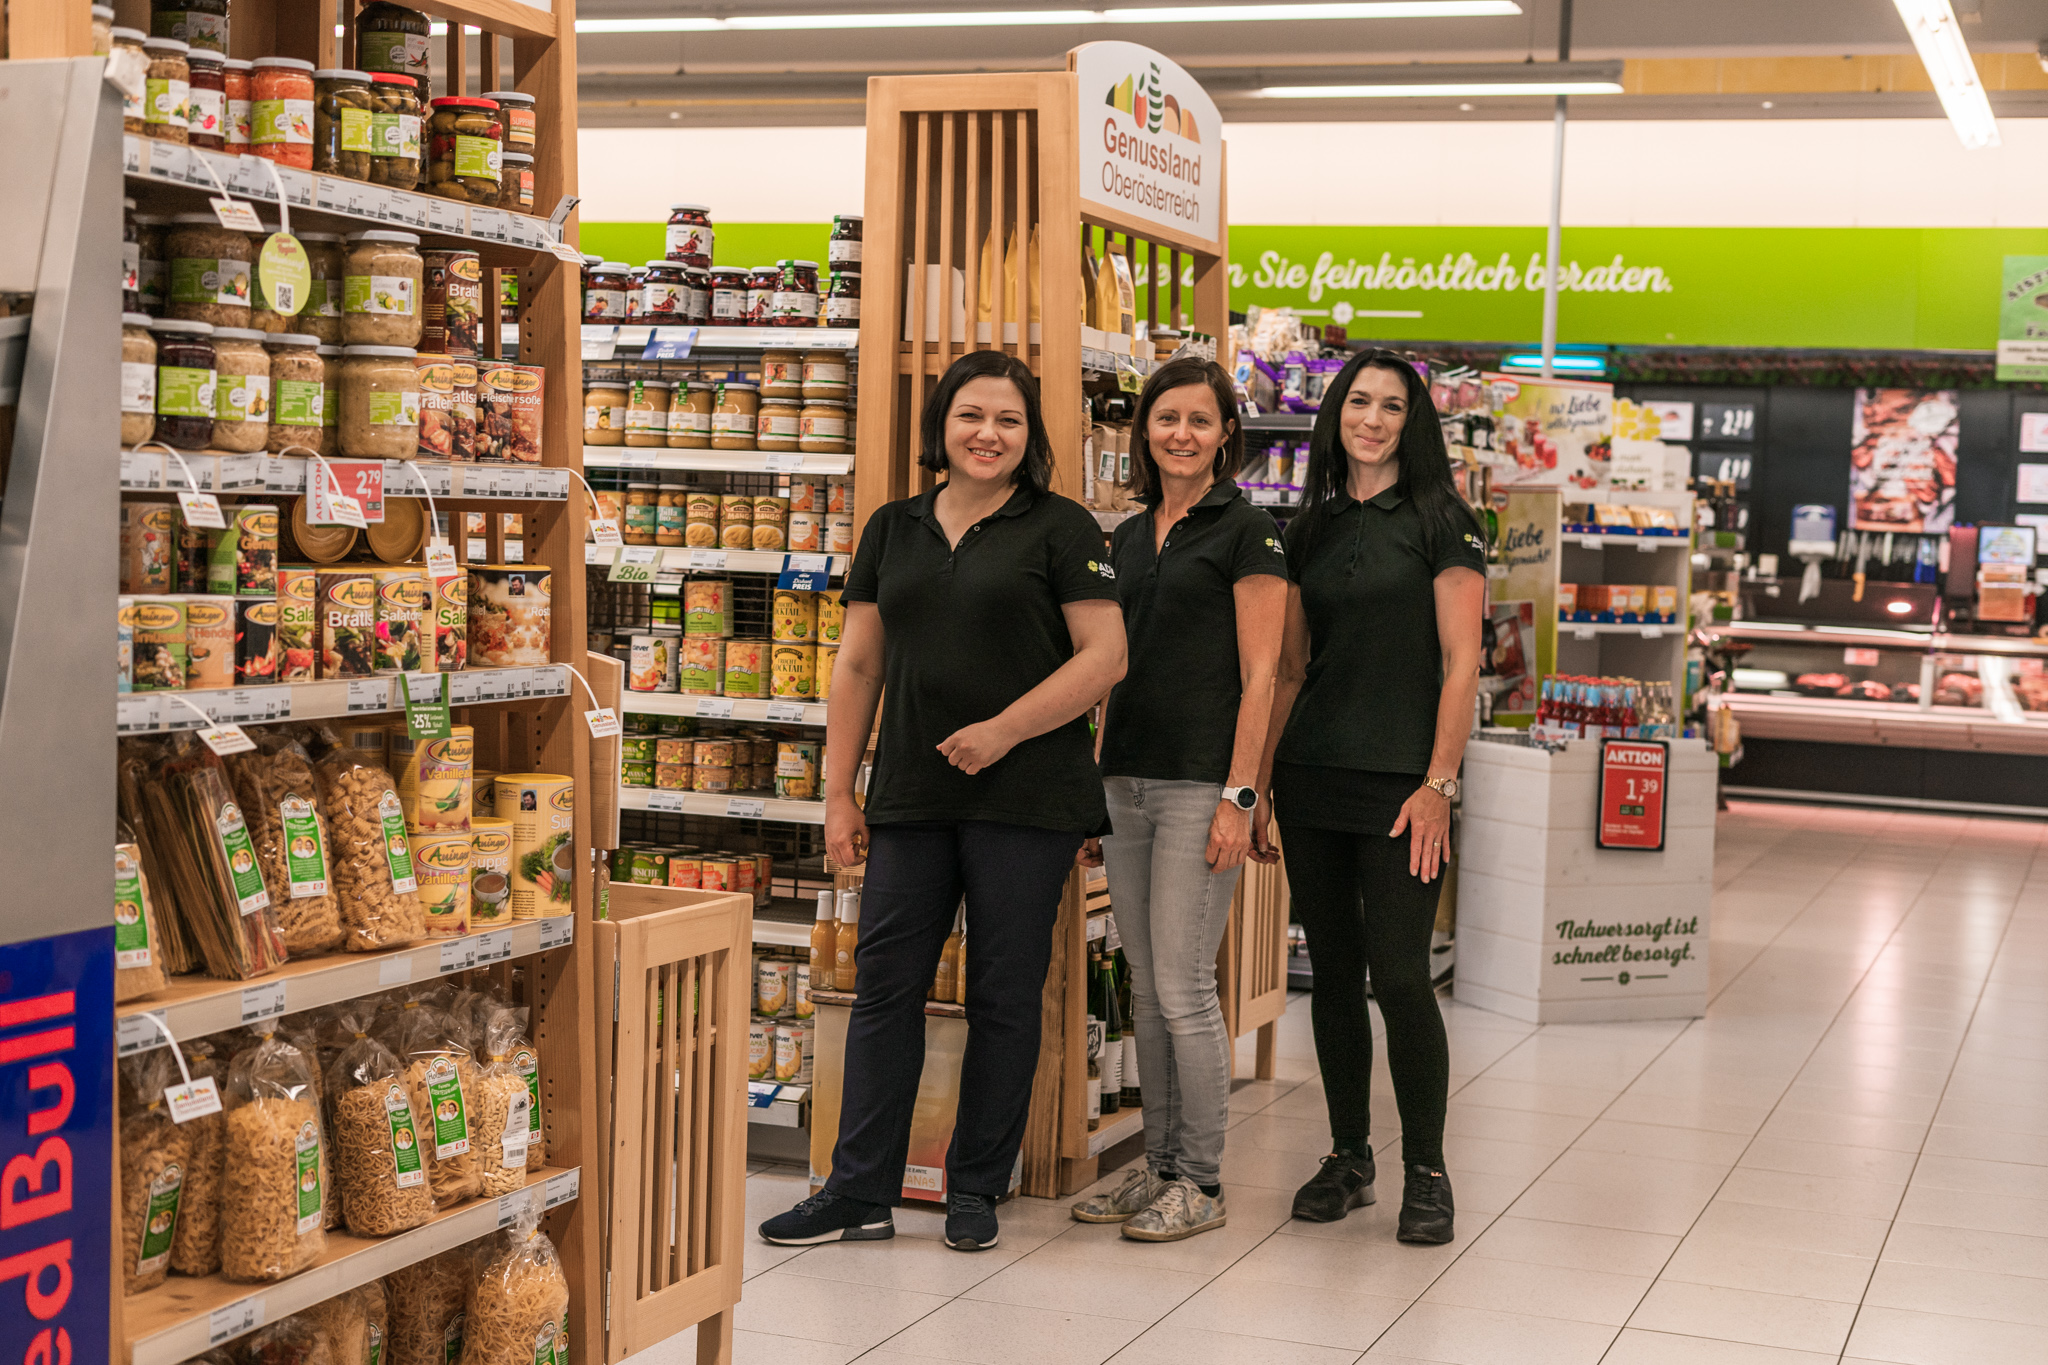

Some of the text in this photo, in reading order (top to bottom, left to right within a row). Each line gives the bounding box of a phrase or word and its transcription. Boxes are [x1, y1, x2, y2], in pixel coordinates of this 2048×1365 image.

[1104, 117, 1201, 187] Genussland
[1102, 161, 1199, 223] Oberösterreich
[1254, 250, 1309, 290] Sie
[1307, 251, 1521, 302] feinköstlich
[315, 463, 323, 520] AKTION
[688, 511, 714, 520] MANGO
[754, 513, 780, 521] MANGO
[617, 565, 649, 581] Bio
[1607, 749, 1663, 765] AKTION
[1626, 778, 1658, 803] 1,39
[1555, 916, 1699, 942] Nahversorgt ist
[1553, 943, 1697, 968] schnell besorgt.
